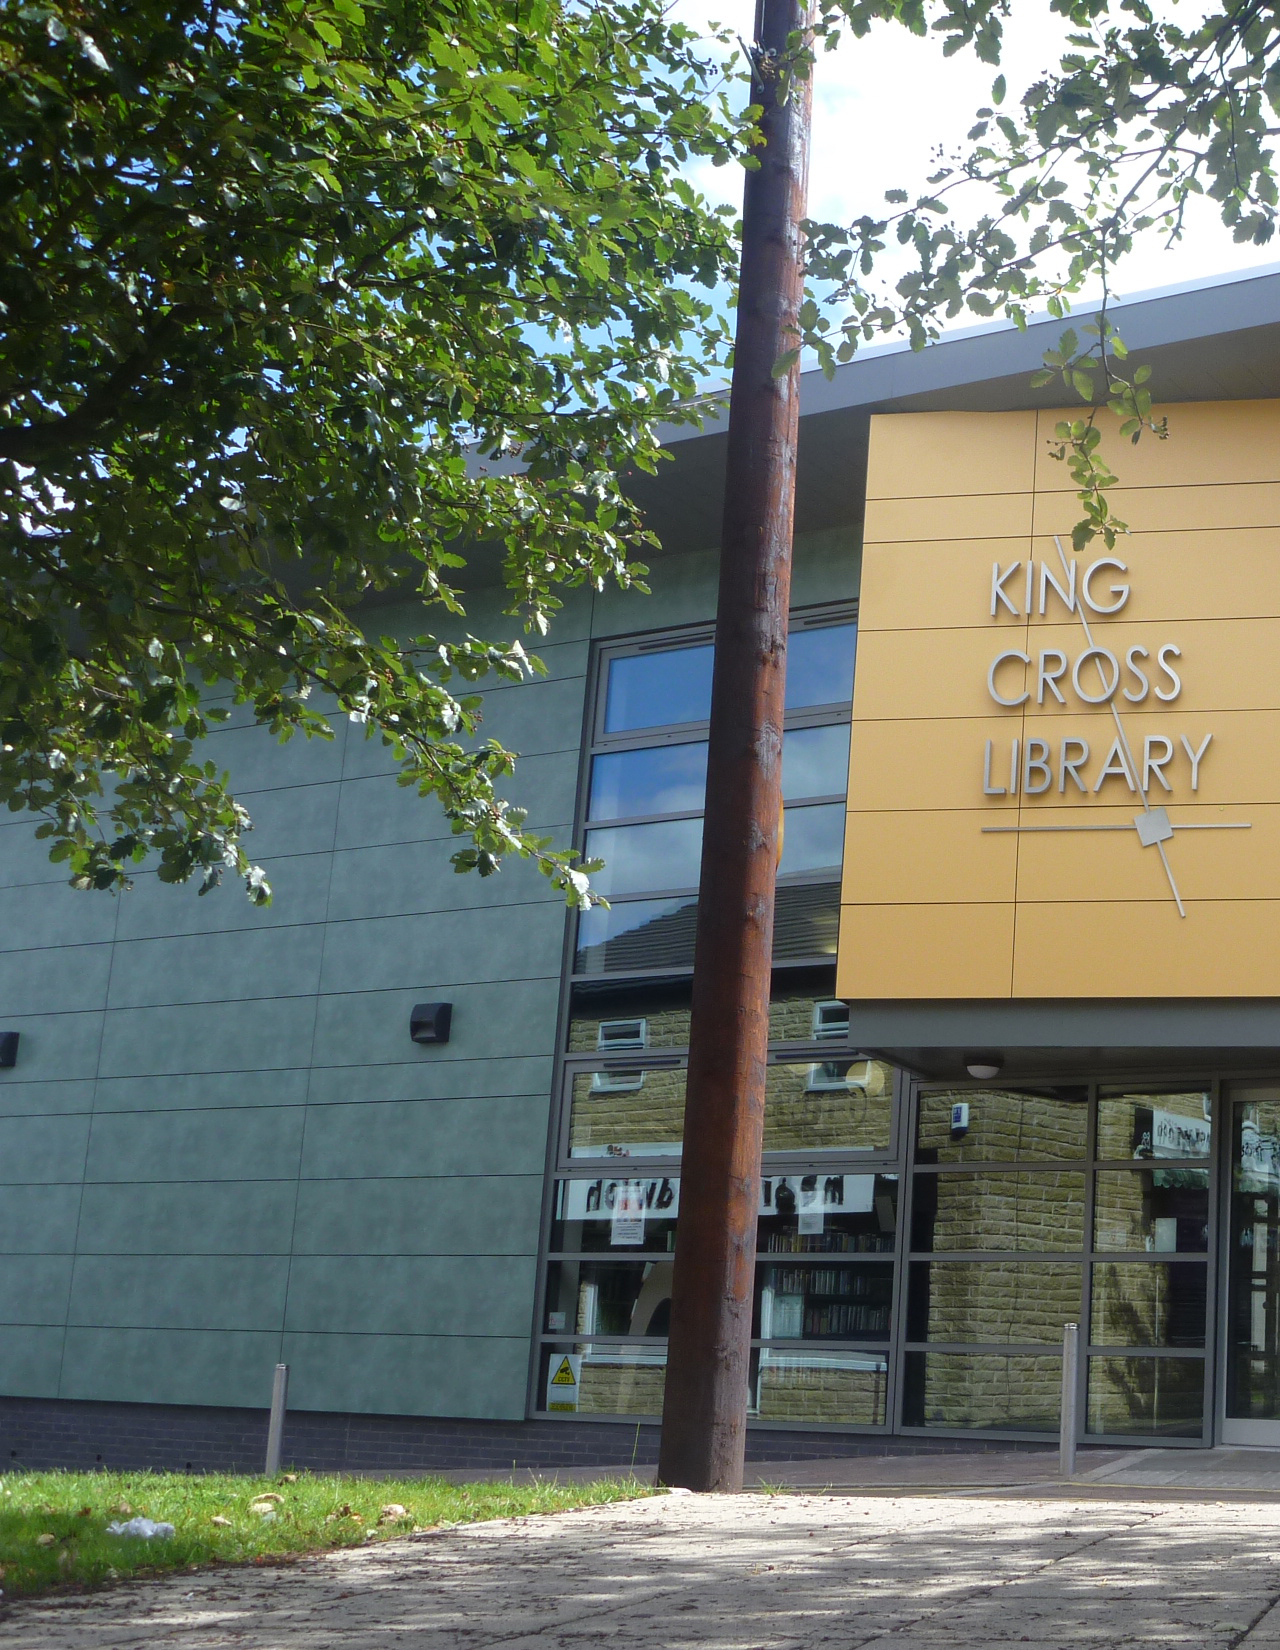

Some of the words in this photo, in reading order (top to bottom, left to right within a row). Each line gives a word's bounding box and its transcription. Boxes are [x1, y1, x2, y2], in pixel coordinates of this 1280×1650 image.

[990, 557, 1130, 616] KING
[987, 644, 1182, 706] CROSS
[983, 733, 1214, 796] LIBRARY
